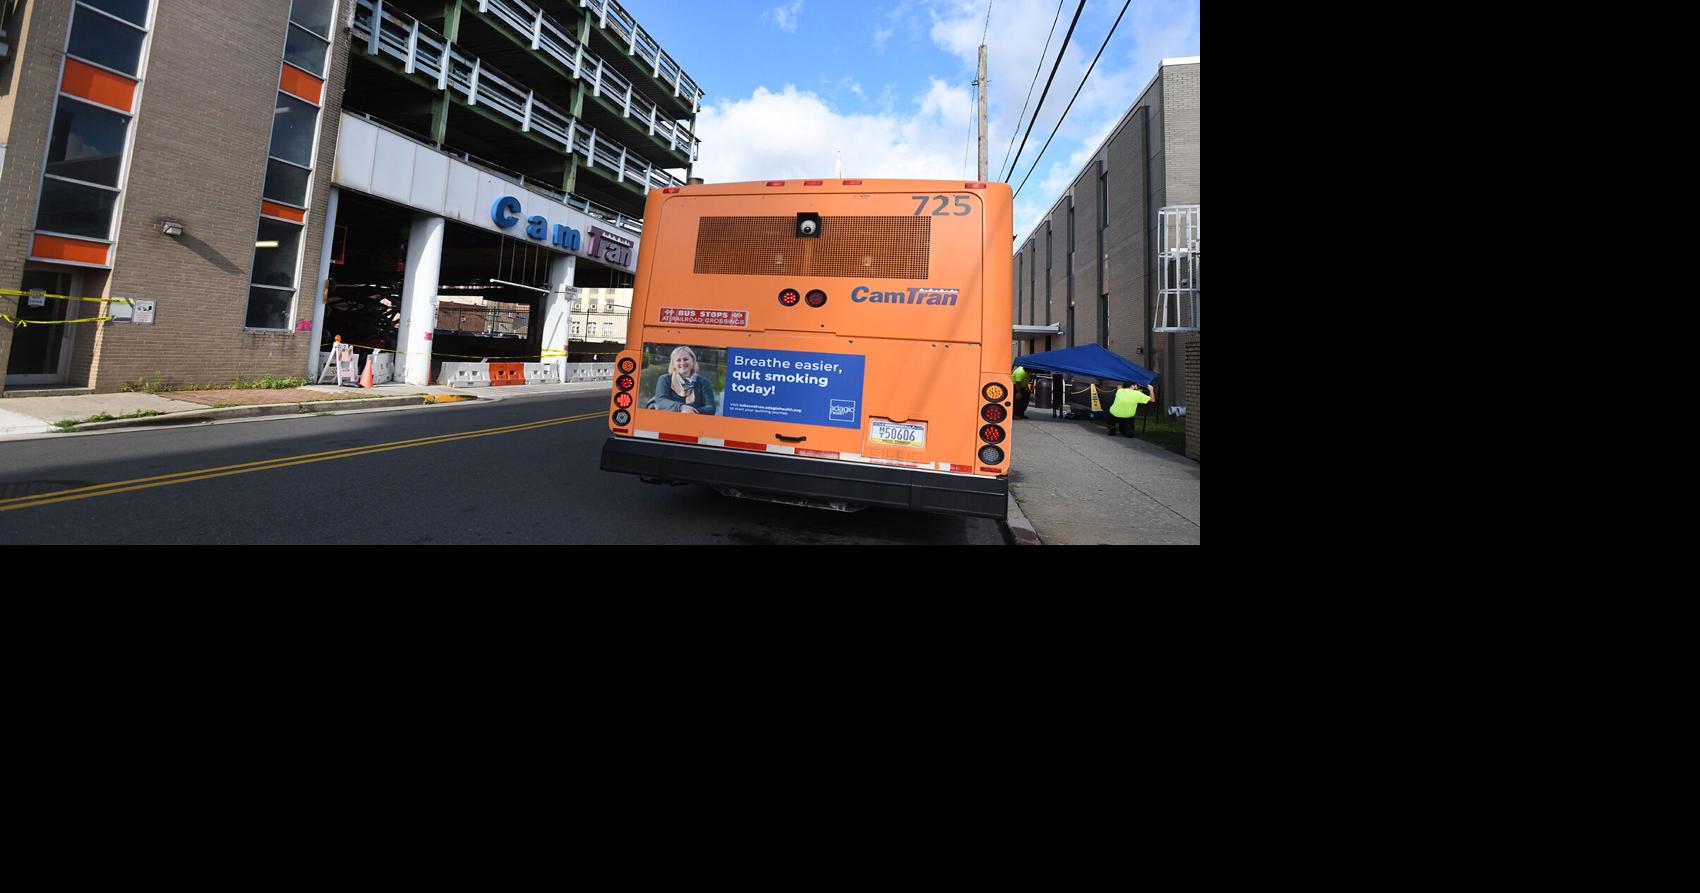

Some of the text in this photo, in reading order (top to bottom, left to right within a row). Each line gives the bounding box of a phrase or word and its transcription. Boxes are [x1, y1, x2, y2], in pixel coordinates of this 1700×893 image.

[911, 194, 972, 217] 725
[851, 285, 960, 306] CamTran
[678, 309, 729, 319] BUS STOPS
[704, 318, 746, 326] CROSSINGS
[734, 355, 843, 375] Breathe easier,
[732, 369, 829, 387] quit smoking
[731, 383, 776, 396] today!
